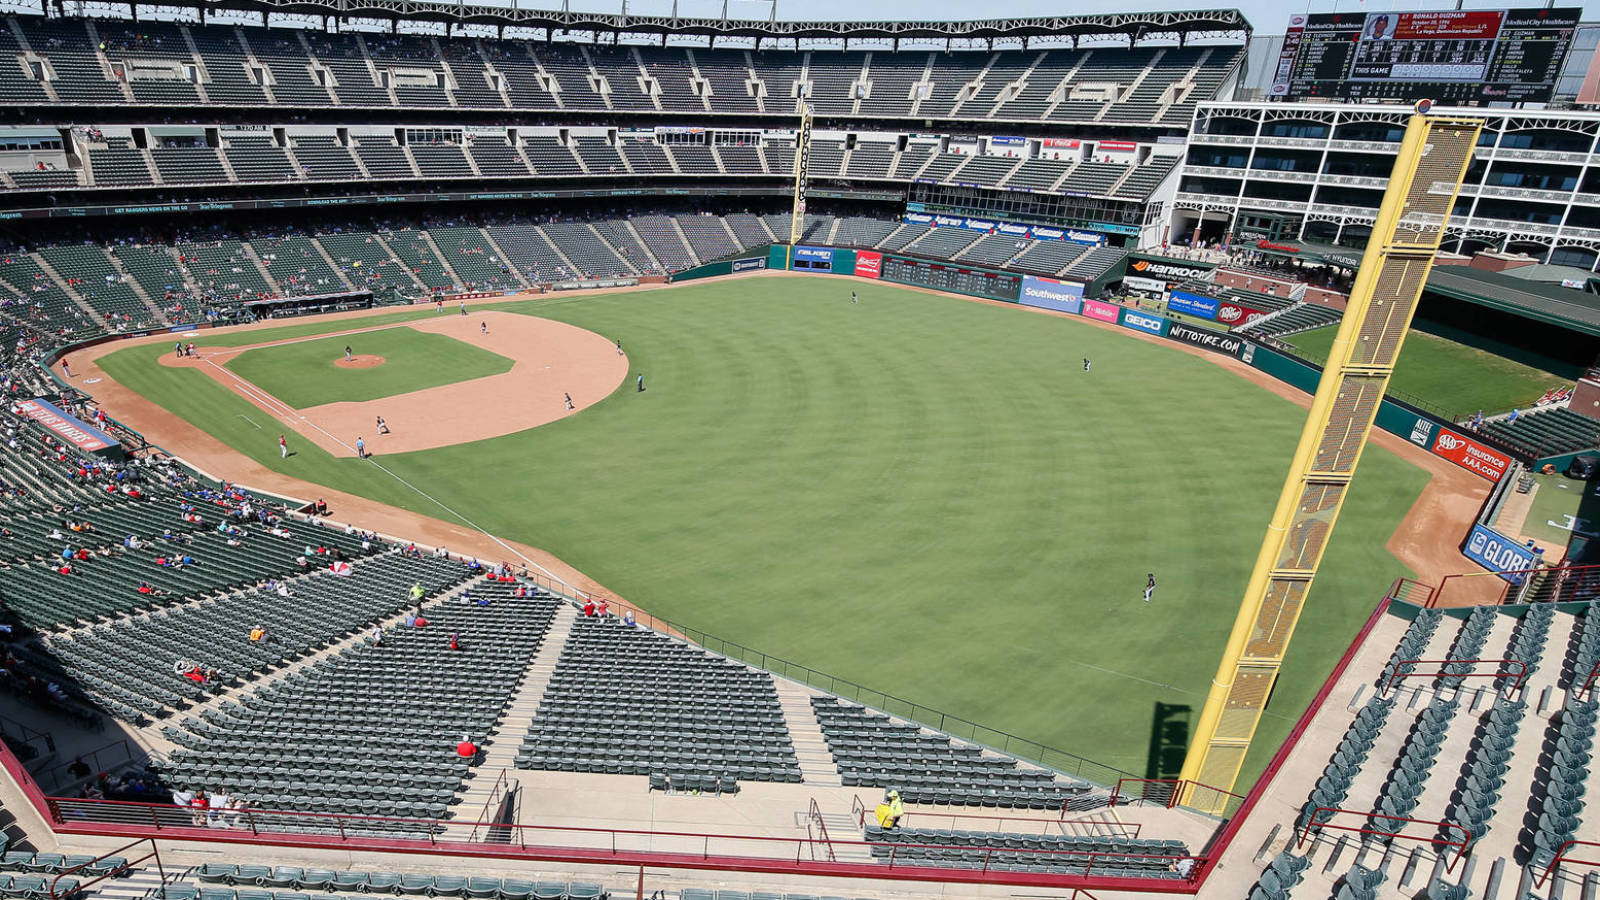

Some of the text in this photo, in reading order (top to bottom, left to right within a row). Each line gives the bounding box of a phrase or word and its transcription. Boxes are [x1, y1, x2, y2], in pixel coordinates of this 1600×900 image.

[803, 121, 811, 144] EAT
[801, 145, 809, 169] MOR
[799, 170, 807, 201] FOWL
[1332, 255, 1358, 266] HYUNDAI
[1025, 287, 1069, 302] Southwest
[1192, 300, 1216, 312] Standard
[1124, 313, 1162, 331] GEICO
[1169, 325, 1240, 356] NITTOTIRE.COM
[1462, 456, 1500, 479] AAA.com
[1466, 444, 1505, 468] Insurance
